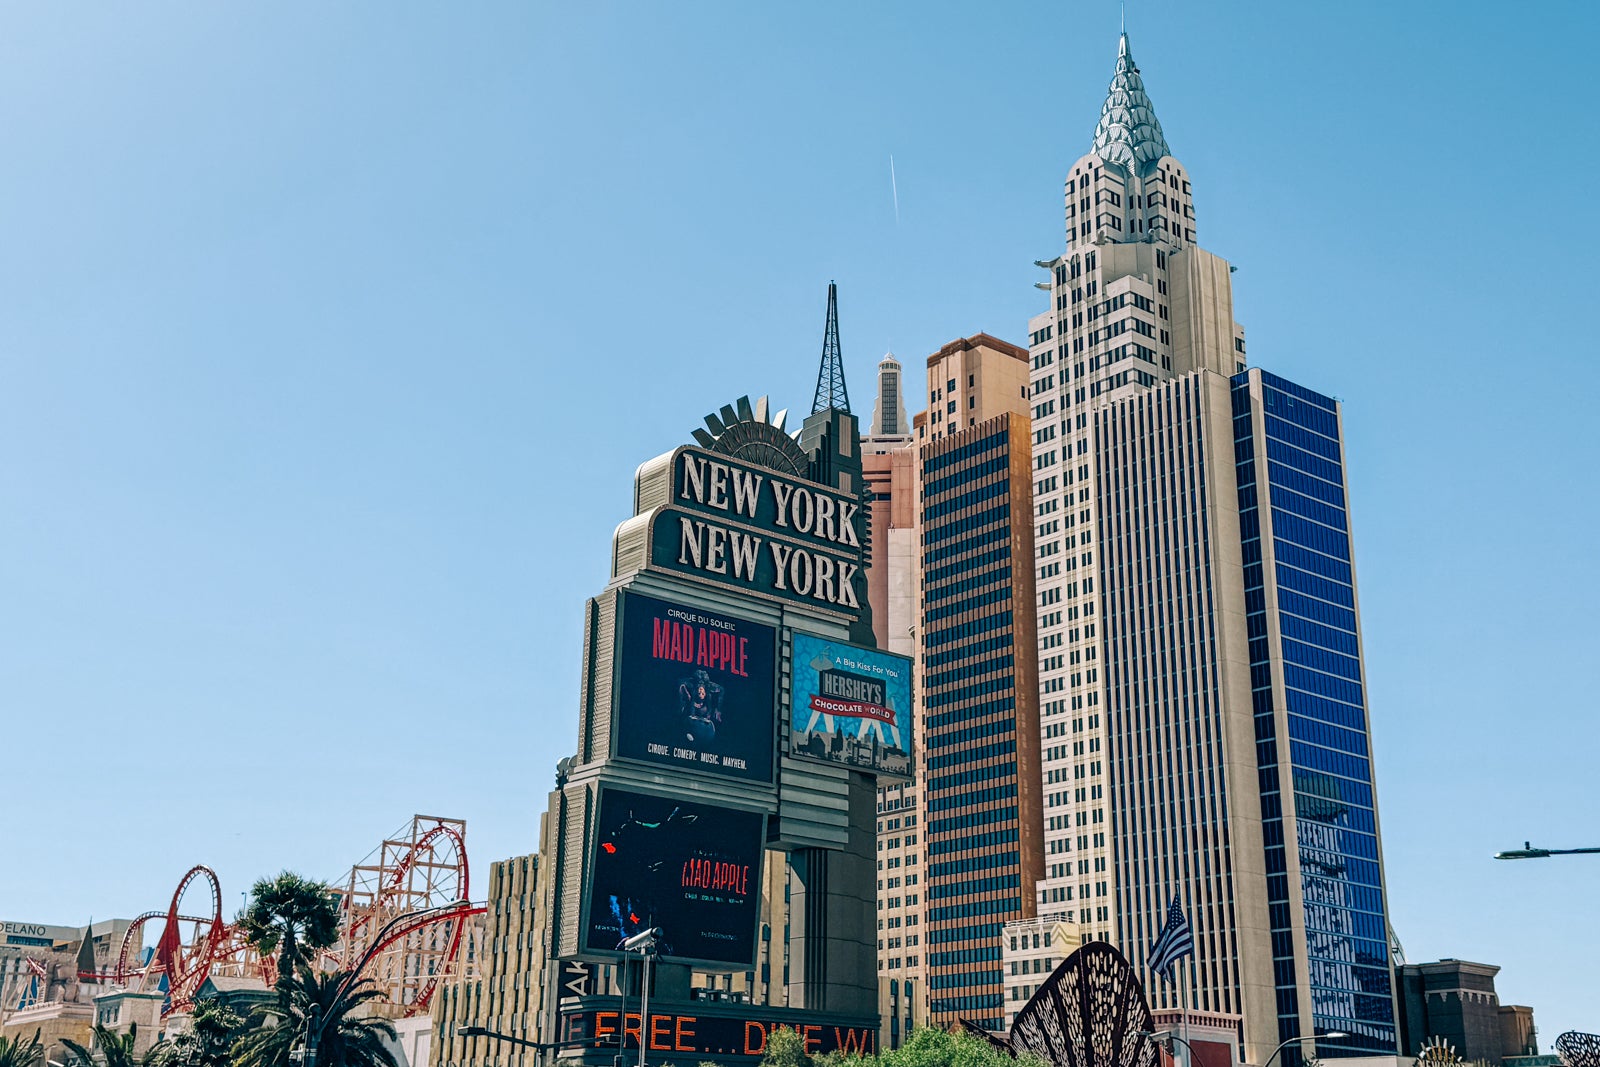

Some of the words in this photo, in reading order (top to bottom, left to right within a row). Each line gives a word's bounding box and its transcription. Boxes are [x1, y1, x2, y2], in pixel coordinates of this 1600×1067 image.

[681, 453, 763, 518] NEW
[770, 479, 860, 547] YORK
[678, 516, 762, 582] NEW
[769, 541, 860, 609] YORK
[667, 608, 697, 623] CIRQUE
[698, 615, 709, 625] DU
[710, 619, 736, 631] SOLEIL
[652, 617, 694, 664] MAD
[697, 627, 749, 678] APPLE
[835, 656, 842, 664] A
[843, 658, 856, 669] Big
[857, 661, 871, 672] Kiss
[872, 665, 884, 674] For
[886, 668, 899, 678] You
[824, 672, 882, 705] HERSHEY'S
[814, 698, 863, 713] CHOCOLATE
[864, 705, 891, 719] WORLD
[647, 742, 670, 756] CIRQUE.
[673, 747, 697, 761] COMEDY.
[700, 752, 720, 765] MUSIC.
[722, 756, 747, 770] MAYHEM.
[711, 861, 749, 895] APPLE
